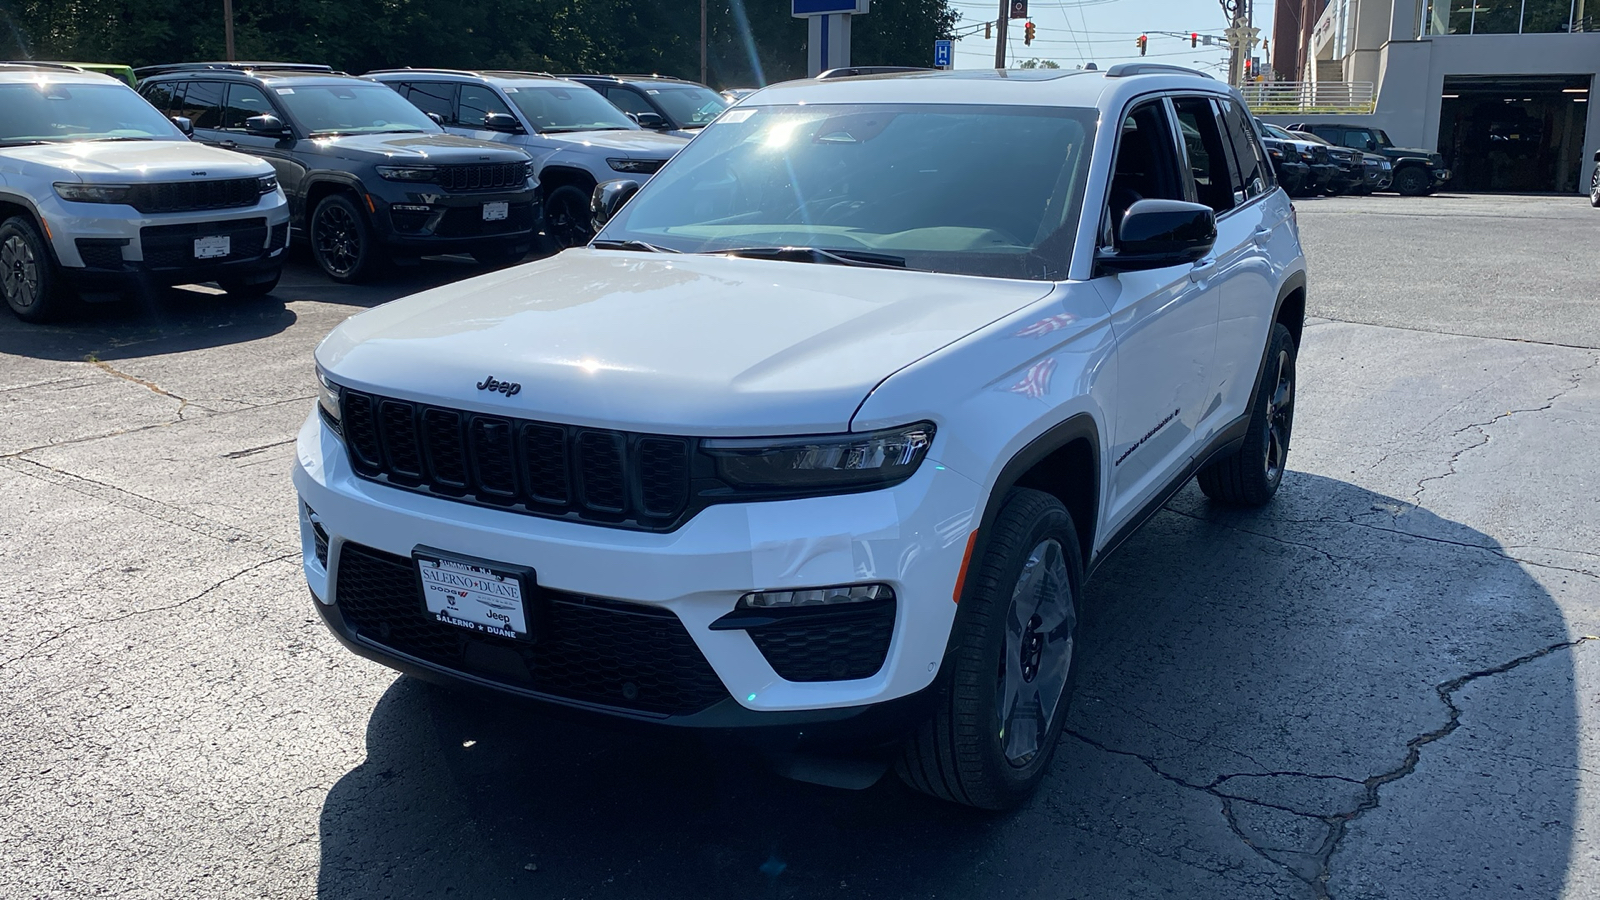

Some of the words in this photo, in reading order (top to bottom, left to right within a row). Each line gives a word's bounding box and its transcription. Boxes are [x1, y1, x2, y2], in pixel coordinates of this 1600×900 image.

[938, 46, 947, 58] H
[476, 375, 522, 398] Jeep
[422, 570, 473, 588] SALERNO
[479, 580, 518, 598] DUANE
[436, 614, 474, 629] SALERNO
[487, 626, 516, 638] DUANE
[486, 610, 510, 624] Jeep
